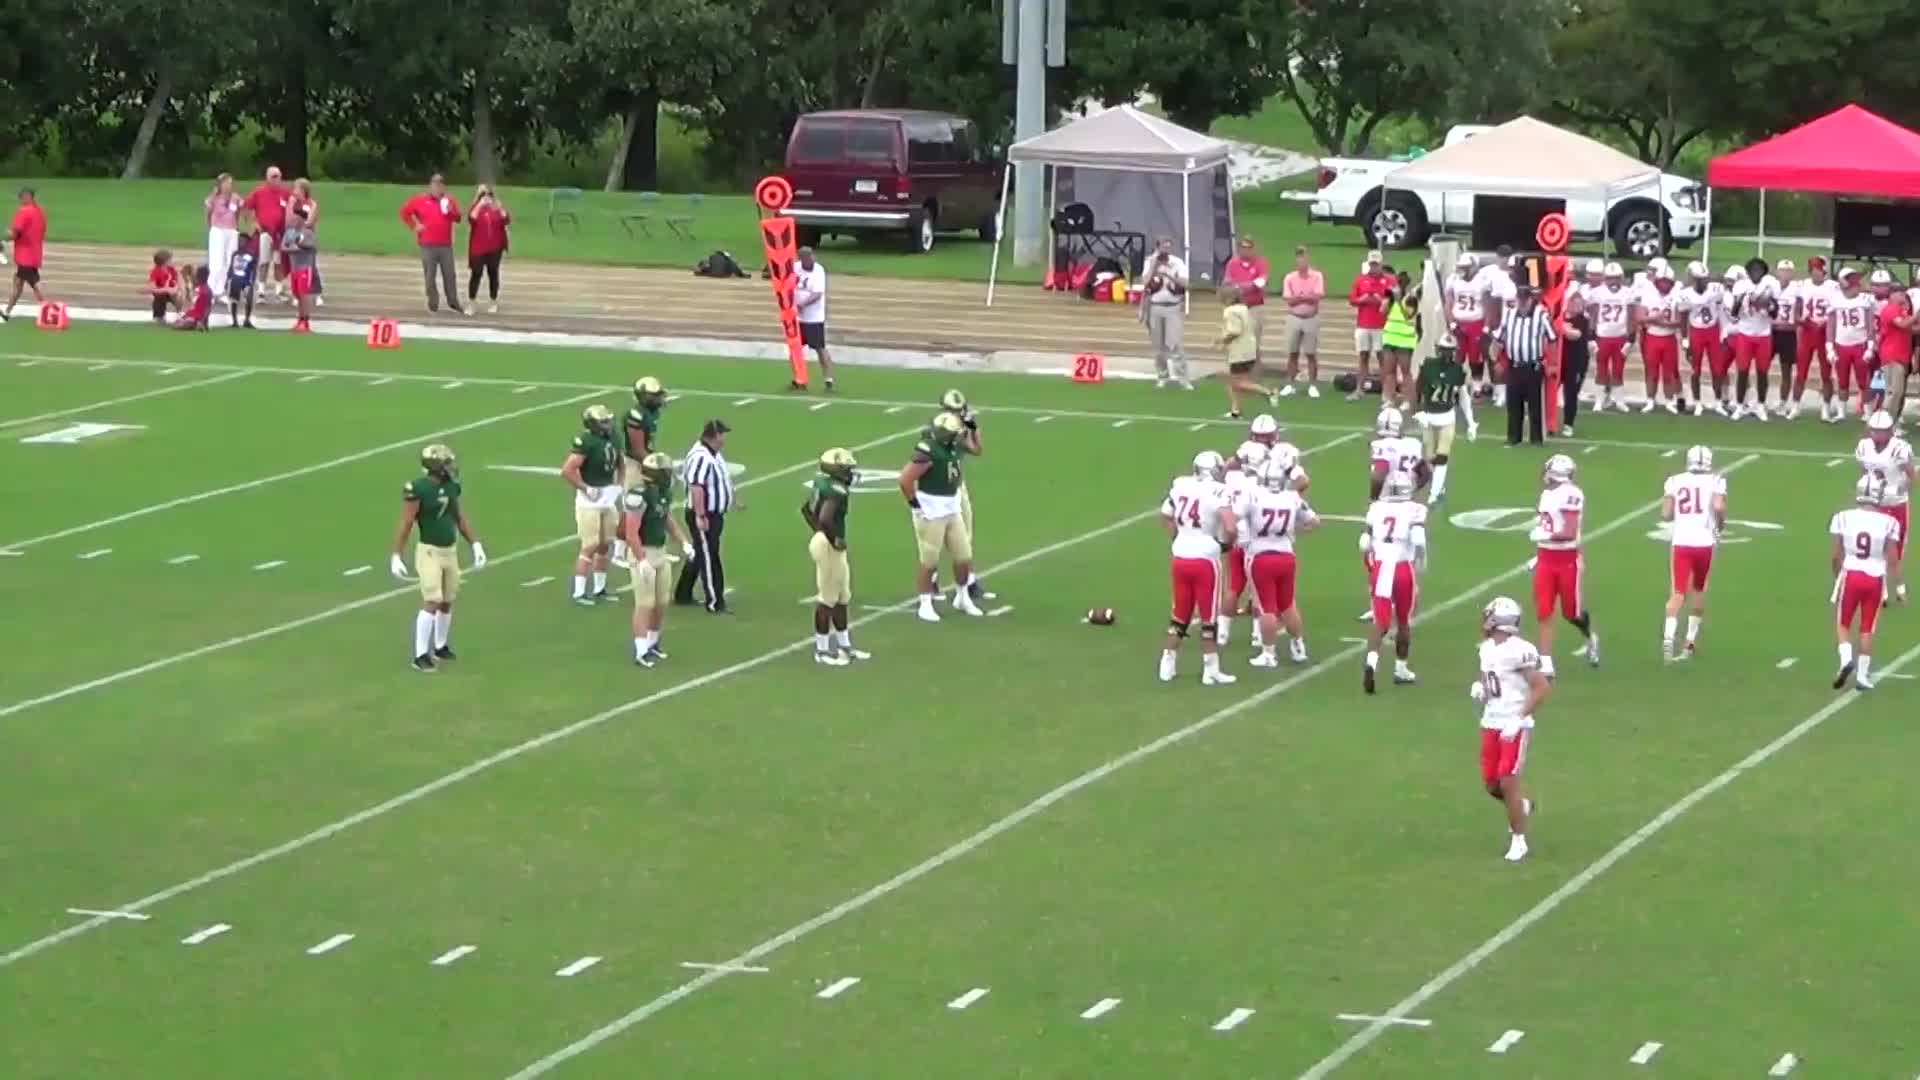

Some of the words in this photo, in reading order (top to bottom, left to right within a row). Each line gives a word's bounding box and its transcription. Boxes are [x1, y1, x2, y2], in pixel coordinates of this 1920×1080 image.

[1524, 257, 1540, 288] 1
[43, 304, 60, 326] G
[1457, 294, 1476, 312] 51
[1601, 303, 1623, 323] 27
[1841, 308, 1860, 327] 16
[370, 322, 392, 344] 10
[1075, 357, 1098, 379] 20
[1177, 495, 1202, 529] 74
[1676, 486, 1705, 514] 21
[1257, 508, 1291, 537] 77
[1382, 516, 1396, 543] 7
[1854, 531, 1872, 560] 9
